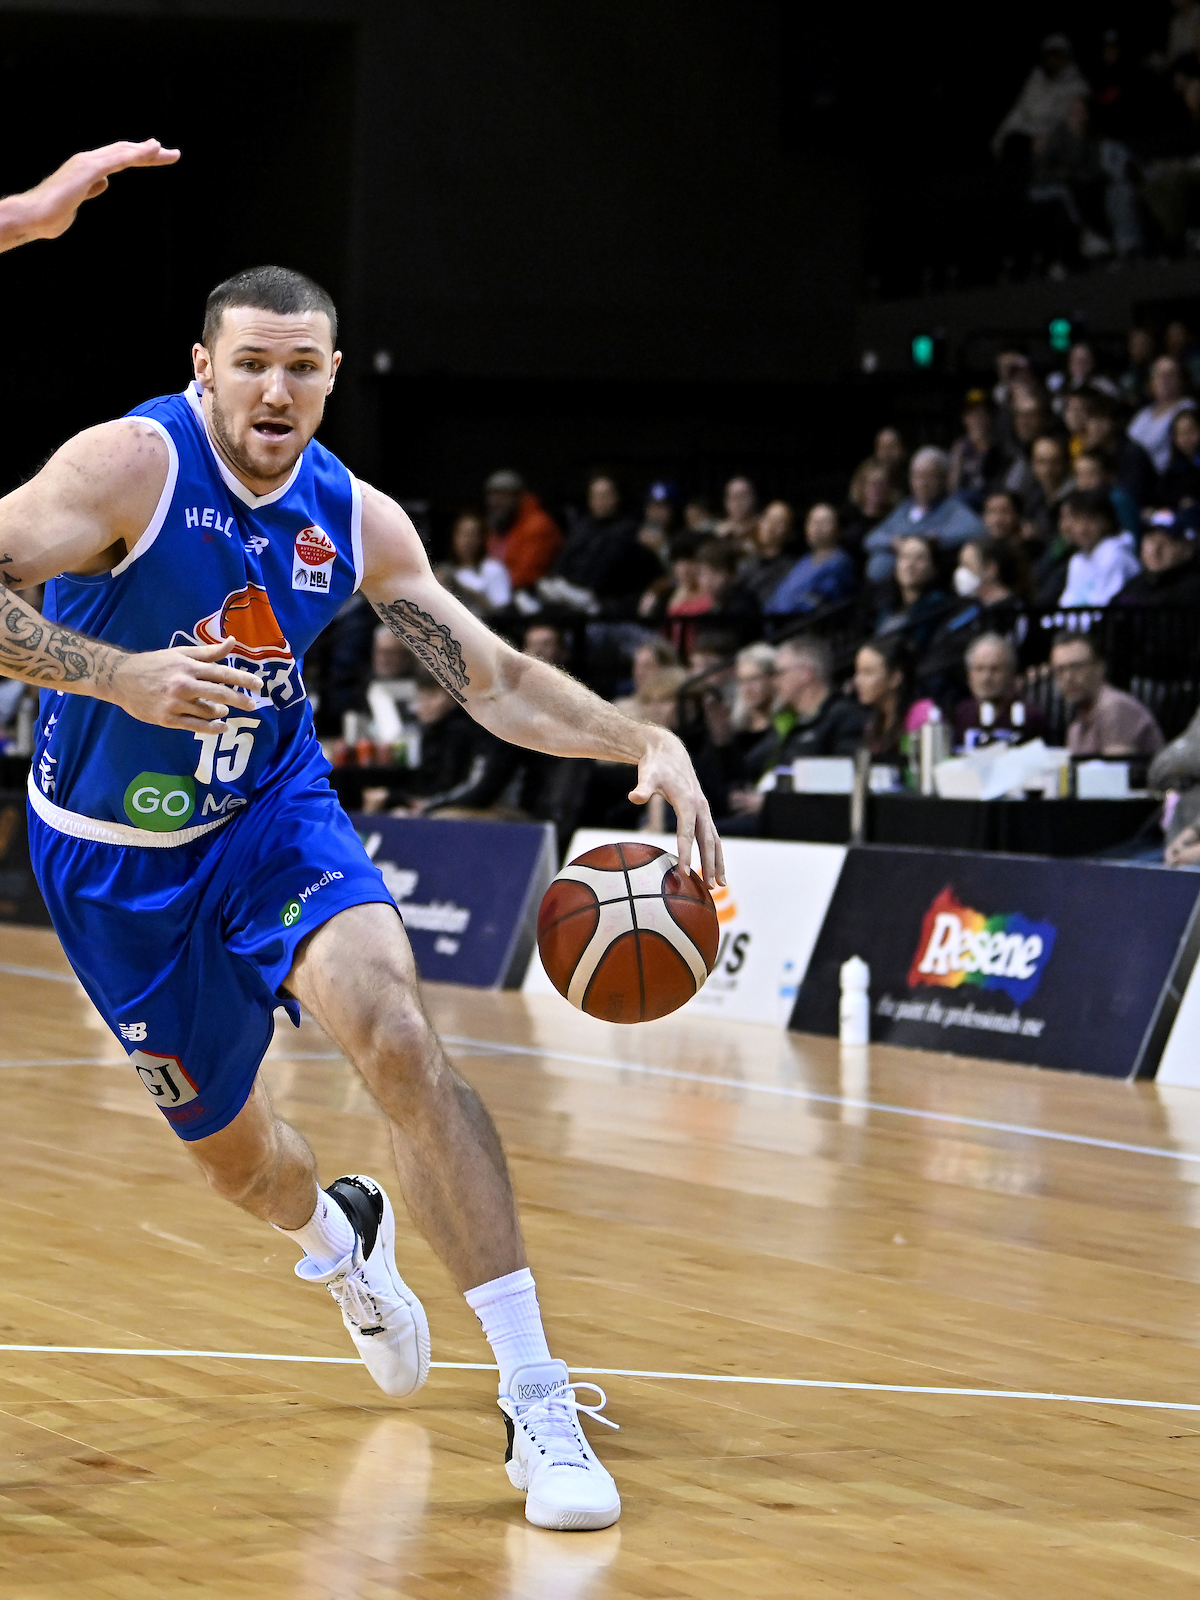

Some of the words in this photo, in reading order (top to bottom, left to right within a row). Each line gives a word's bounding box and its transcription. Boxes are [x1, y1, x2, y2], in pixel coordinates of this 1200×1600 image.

[185, 507, 234, 538] HELL
[310, 570, 328, 585] NBL
[193, 716, 262, 785] 15
[131, 786, 190, 817] GO
[283, 902, 300, 927] GO
[298, 870, 345, 904] Media
[918, 912, 1043, 980] Resene
